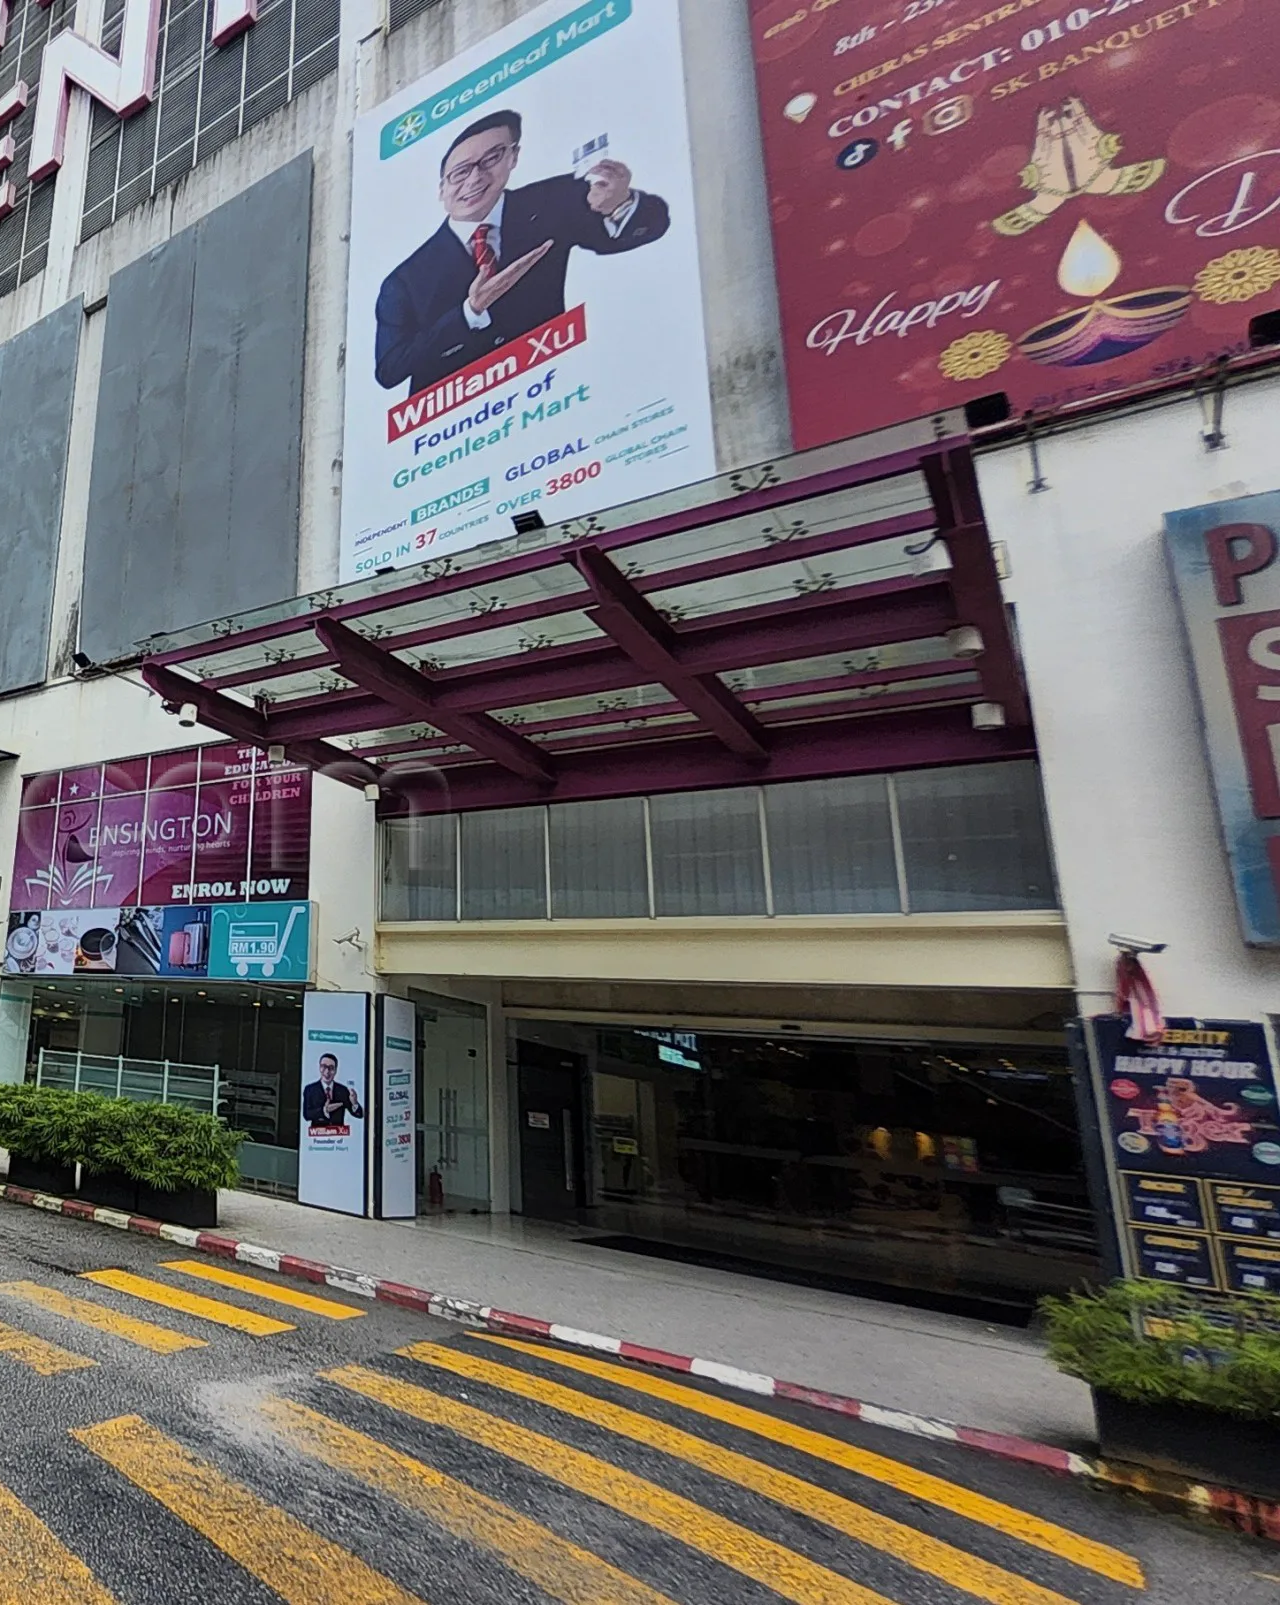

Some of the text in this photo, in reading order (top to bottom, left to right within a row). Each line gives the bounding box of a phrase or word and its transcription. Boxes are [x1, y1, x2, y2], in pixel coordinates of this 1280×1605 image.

[431, 1, 617, 120] Greenleaf Mart
[833, 24, 879, 56] 8th
[833, 43, 930, 96] CHERAS
[990, 0, 1199, 101] SK BANQUET
[828, 47, 1014, 138] CONTACT:
[806, 148, 1280, 356] Happy D
[392, 322, 576, 434] William Xu
[413, 369, 557, 455] Founder of
[355, 405, 675, 546] INDEPENDENT BRANDS GLOBAL CHAIN STORES
[392, 384, 590, 489] Greenleaf Mart
[355, 551, 392, 574] SOLD
[396, 542, 411, 558] IN
[415, 528, 438, 550] 37
[438, 514, 490, 540] COUNTRIES
[496, 488, 542, 516] OVER
[545, 460, 602, 496] 3800
[229, 787, 301, 805] CHLDREN
[265, 773, 301, 786] YOUR
[171, 878, 291, 899] ENROL NOW
